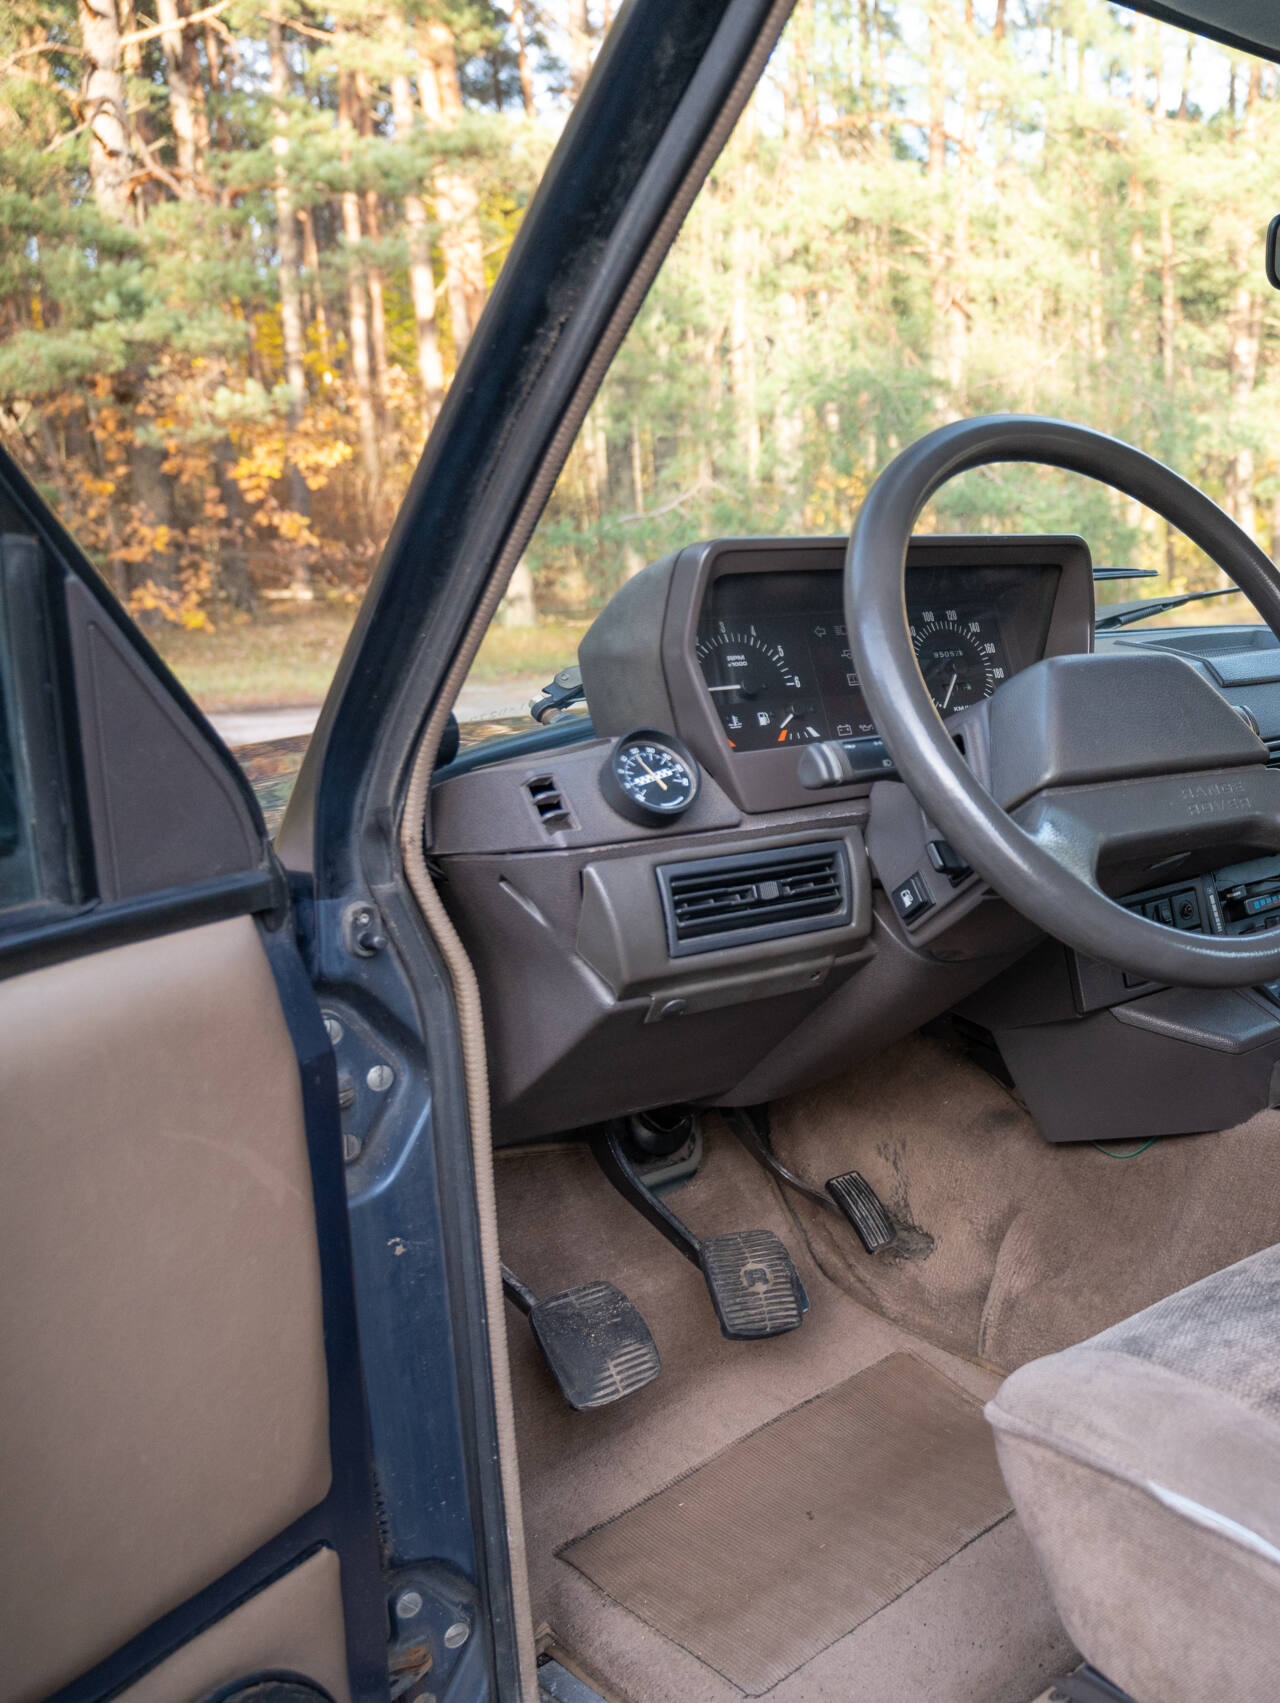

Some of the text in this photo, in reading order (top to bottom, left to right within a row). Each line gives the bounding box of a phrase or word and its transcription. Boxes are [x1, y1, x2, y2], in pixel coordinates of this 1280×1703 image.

[922, 611, 935, 622] 100
[945, 610, 958, 621] 120
[968, 622, 981, 633] 140
[777, 645, 785, 657] 5
[984, 643, 996, 654] 160
[992, 668, 1005, 679] 180
[794, 676, 801, 688] 6
